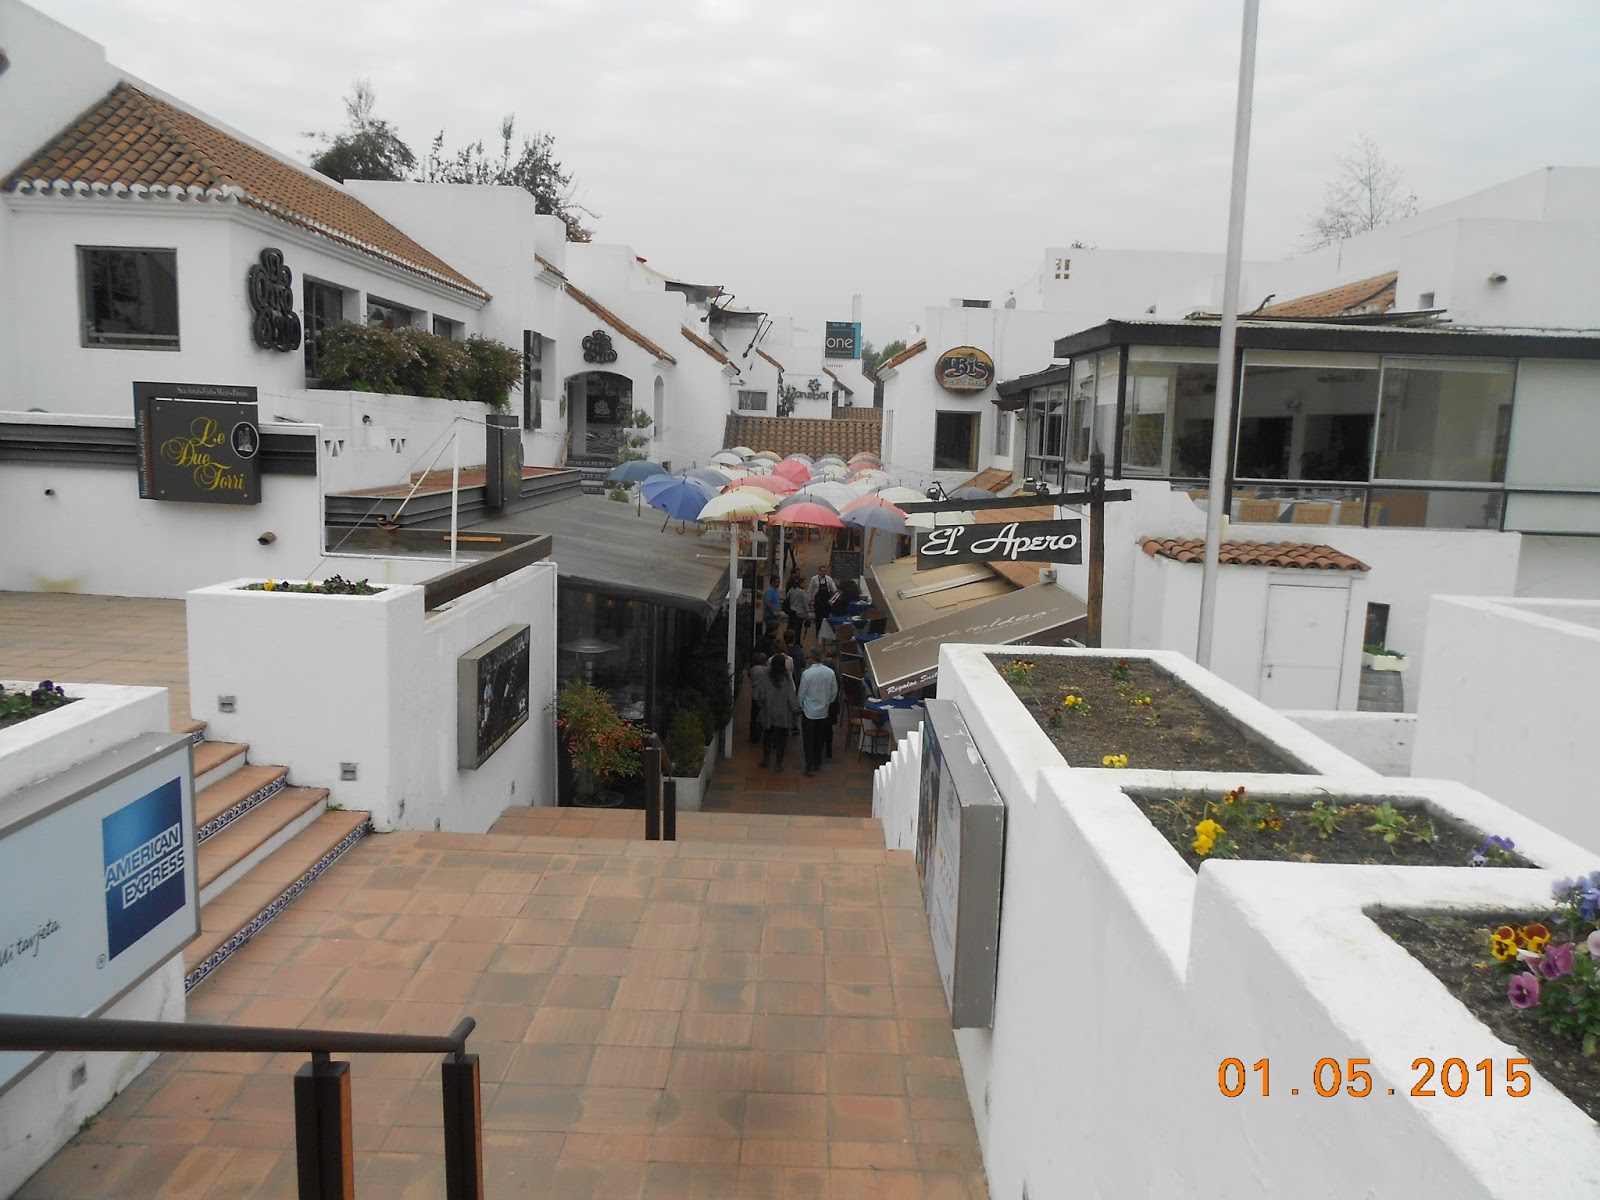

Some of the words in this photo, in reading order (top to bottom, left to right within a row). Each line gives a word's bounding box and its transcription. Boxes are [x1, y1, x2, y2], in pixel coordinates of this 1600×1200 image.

[826, 338, 853, 348] one
[190, 417, 225, 448] Le
[161, 437, 211, 467] Due
[193, 462, 244, 491] Torri
[920, 526, 965, 555] El
[970, 522, 1077, 560] Apero
[886, 680, 918, 695] Regalos
[105, 826, 179, 890] AMERICAN
[124, 850, 185, 904] EXPRESS
